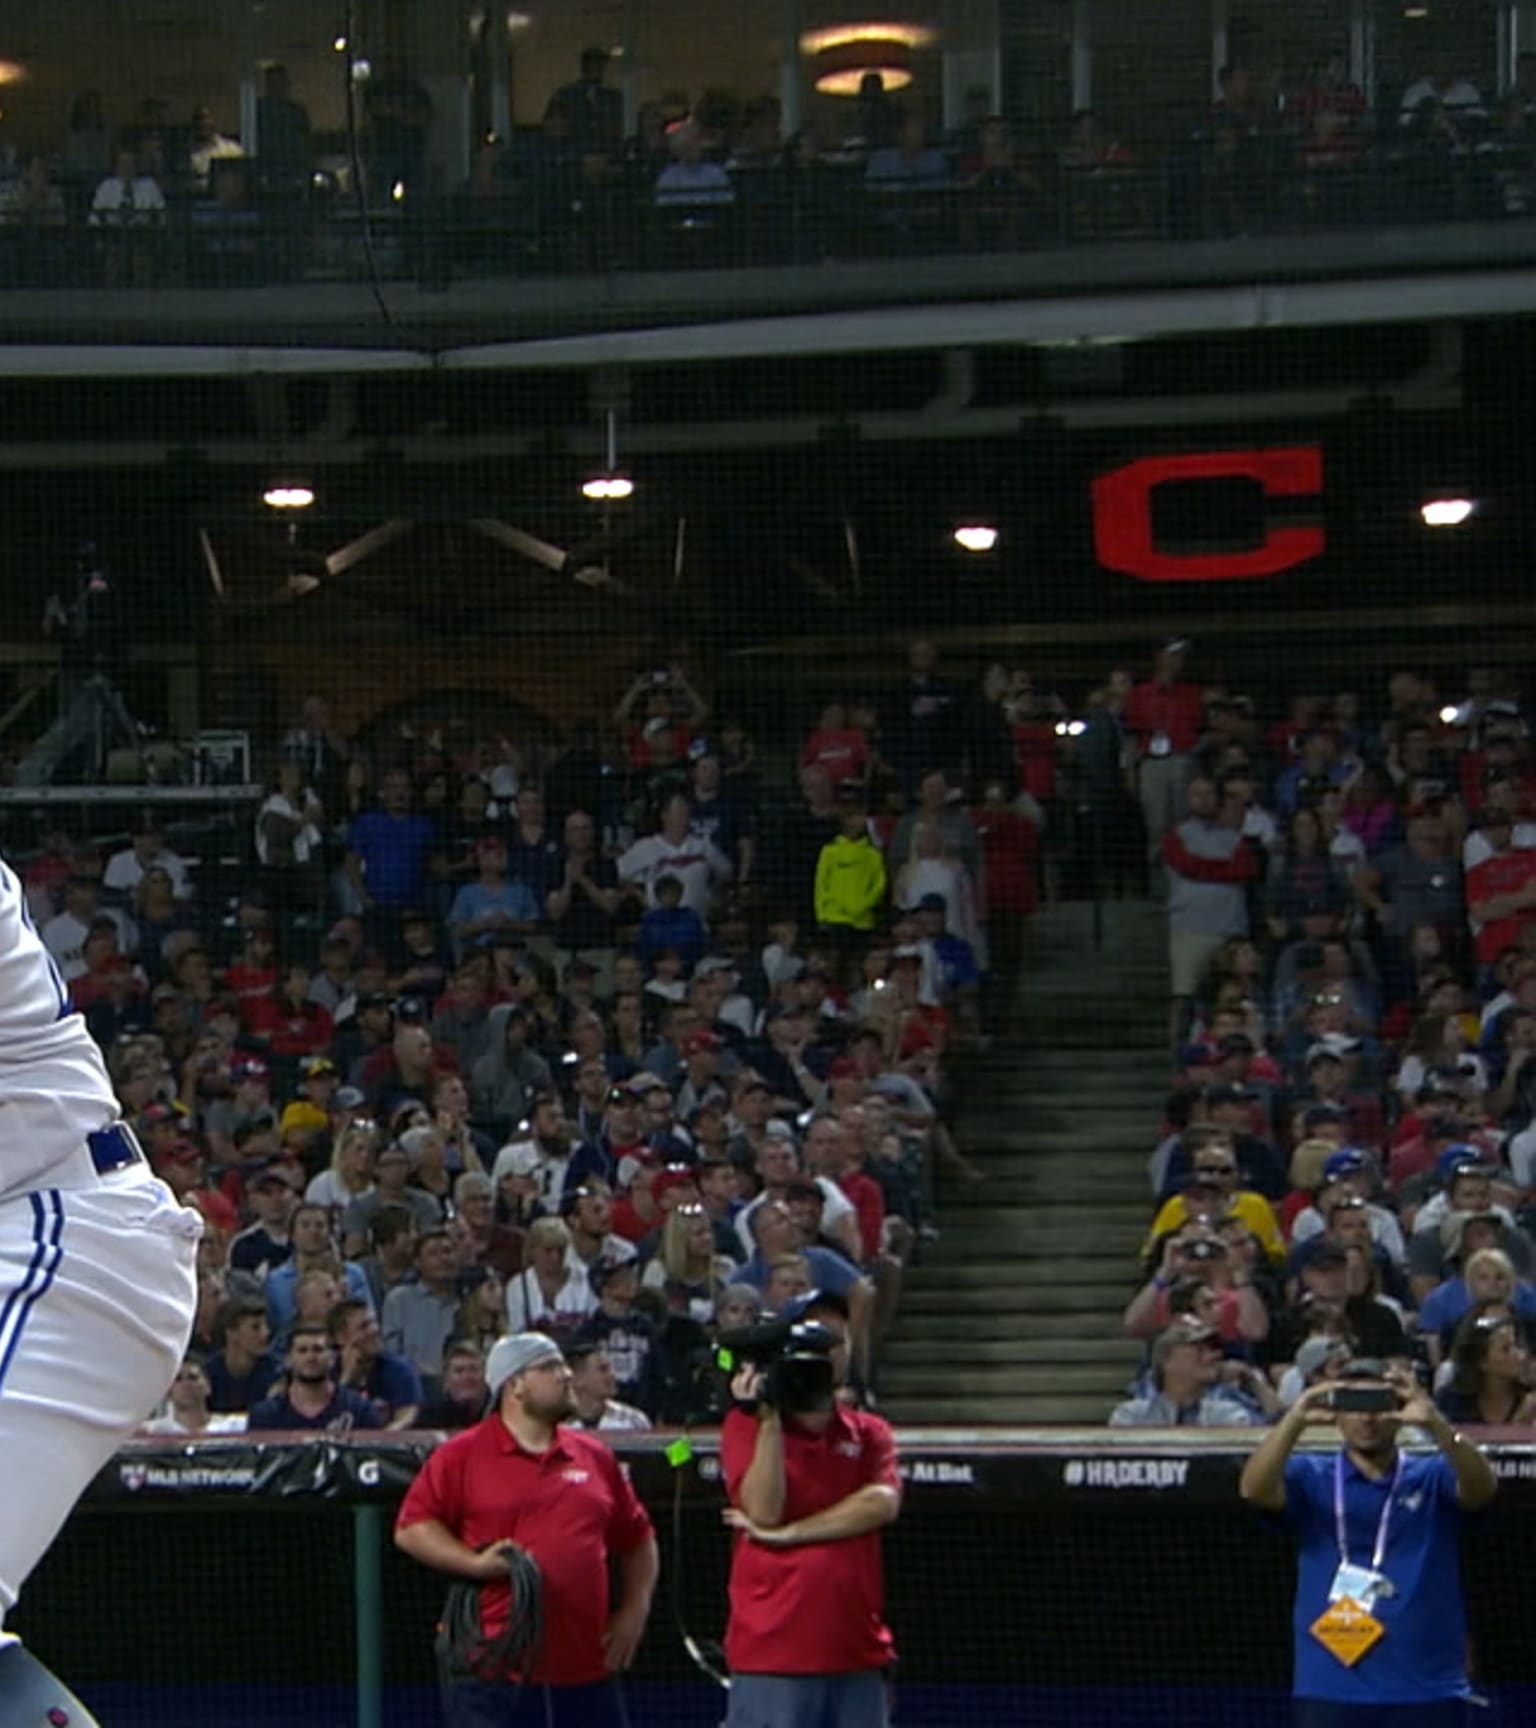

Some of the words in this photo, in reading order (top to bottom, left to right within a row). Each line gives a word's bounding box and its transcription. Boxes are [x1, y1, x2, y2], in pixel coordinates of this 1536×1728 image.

[1090, 443, 1325, 583] C
[358, 1463, 381, 1485] G
[913, 1463, 936, 1481] At
[939, 1463, 972, 1482] Bat
[1065, 1460, 1189, 1488] #HRDERBY
